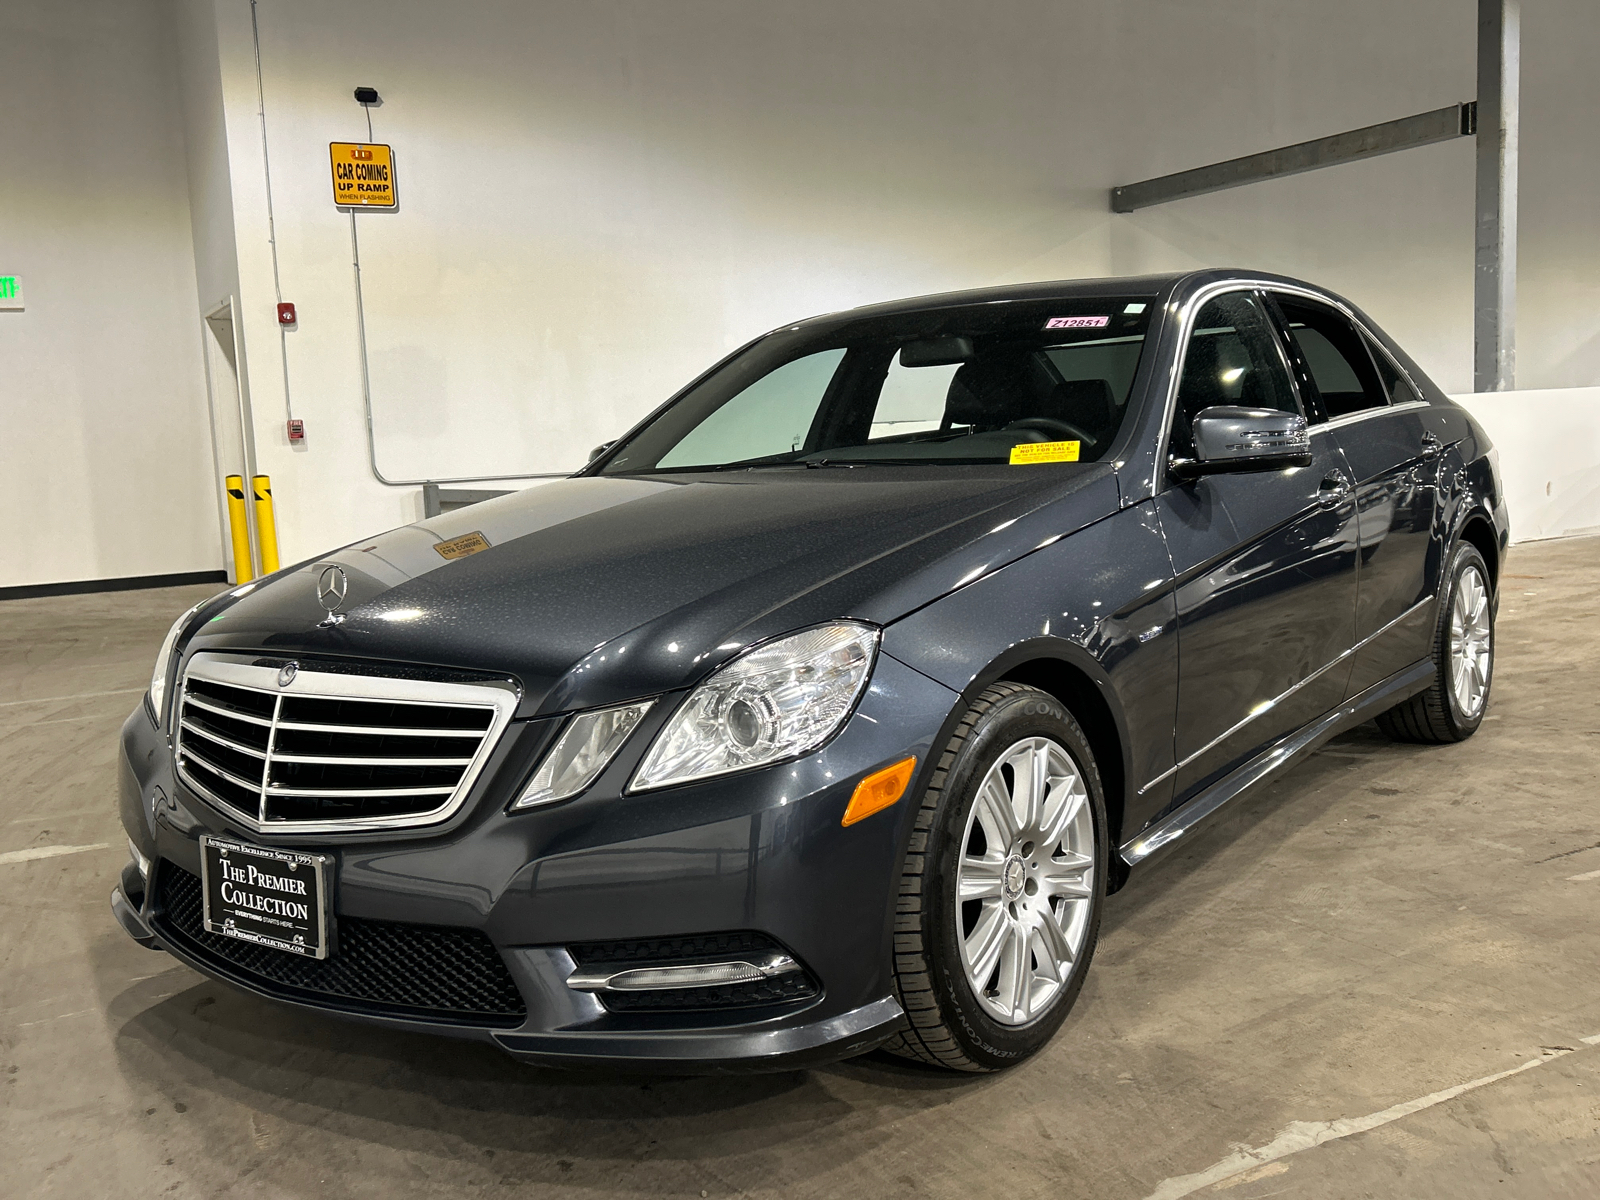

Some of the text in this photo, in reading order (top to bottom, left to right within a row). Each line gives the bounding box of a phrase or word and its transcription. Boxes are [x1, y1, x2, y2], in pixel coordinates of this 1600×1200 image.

[336, 162, 388, 182] CAR COMING
[338, 182, 390, 193] UP RAMP
[360, 194, 391, 202] FLASHING
[0, 276, 16, 299] IT
[207, 838, 312, 865] AUTOMOTIVE EXCELLENCE SINCE 1995
[219, 858, 307, 896] THE PREMIER
[220, 881, 308, 920] COLLECTION
[234, 909, 262, 922] EVERYTHING
[262, 916, 280, 926] STARTS
